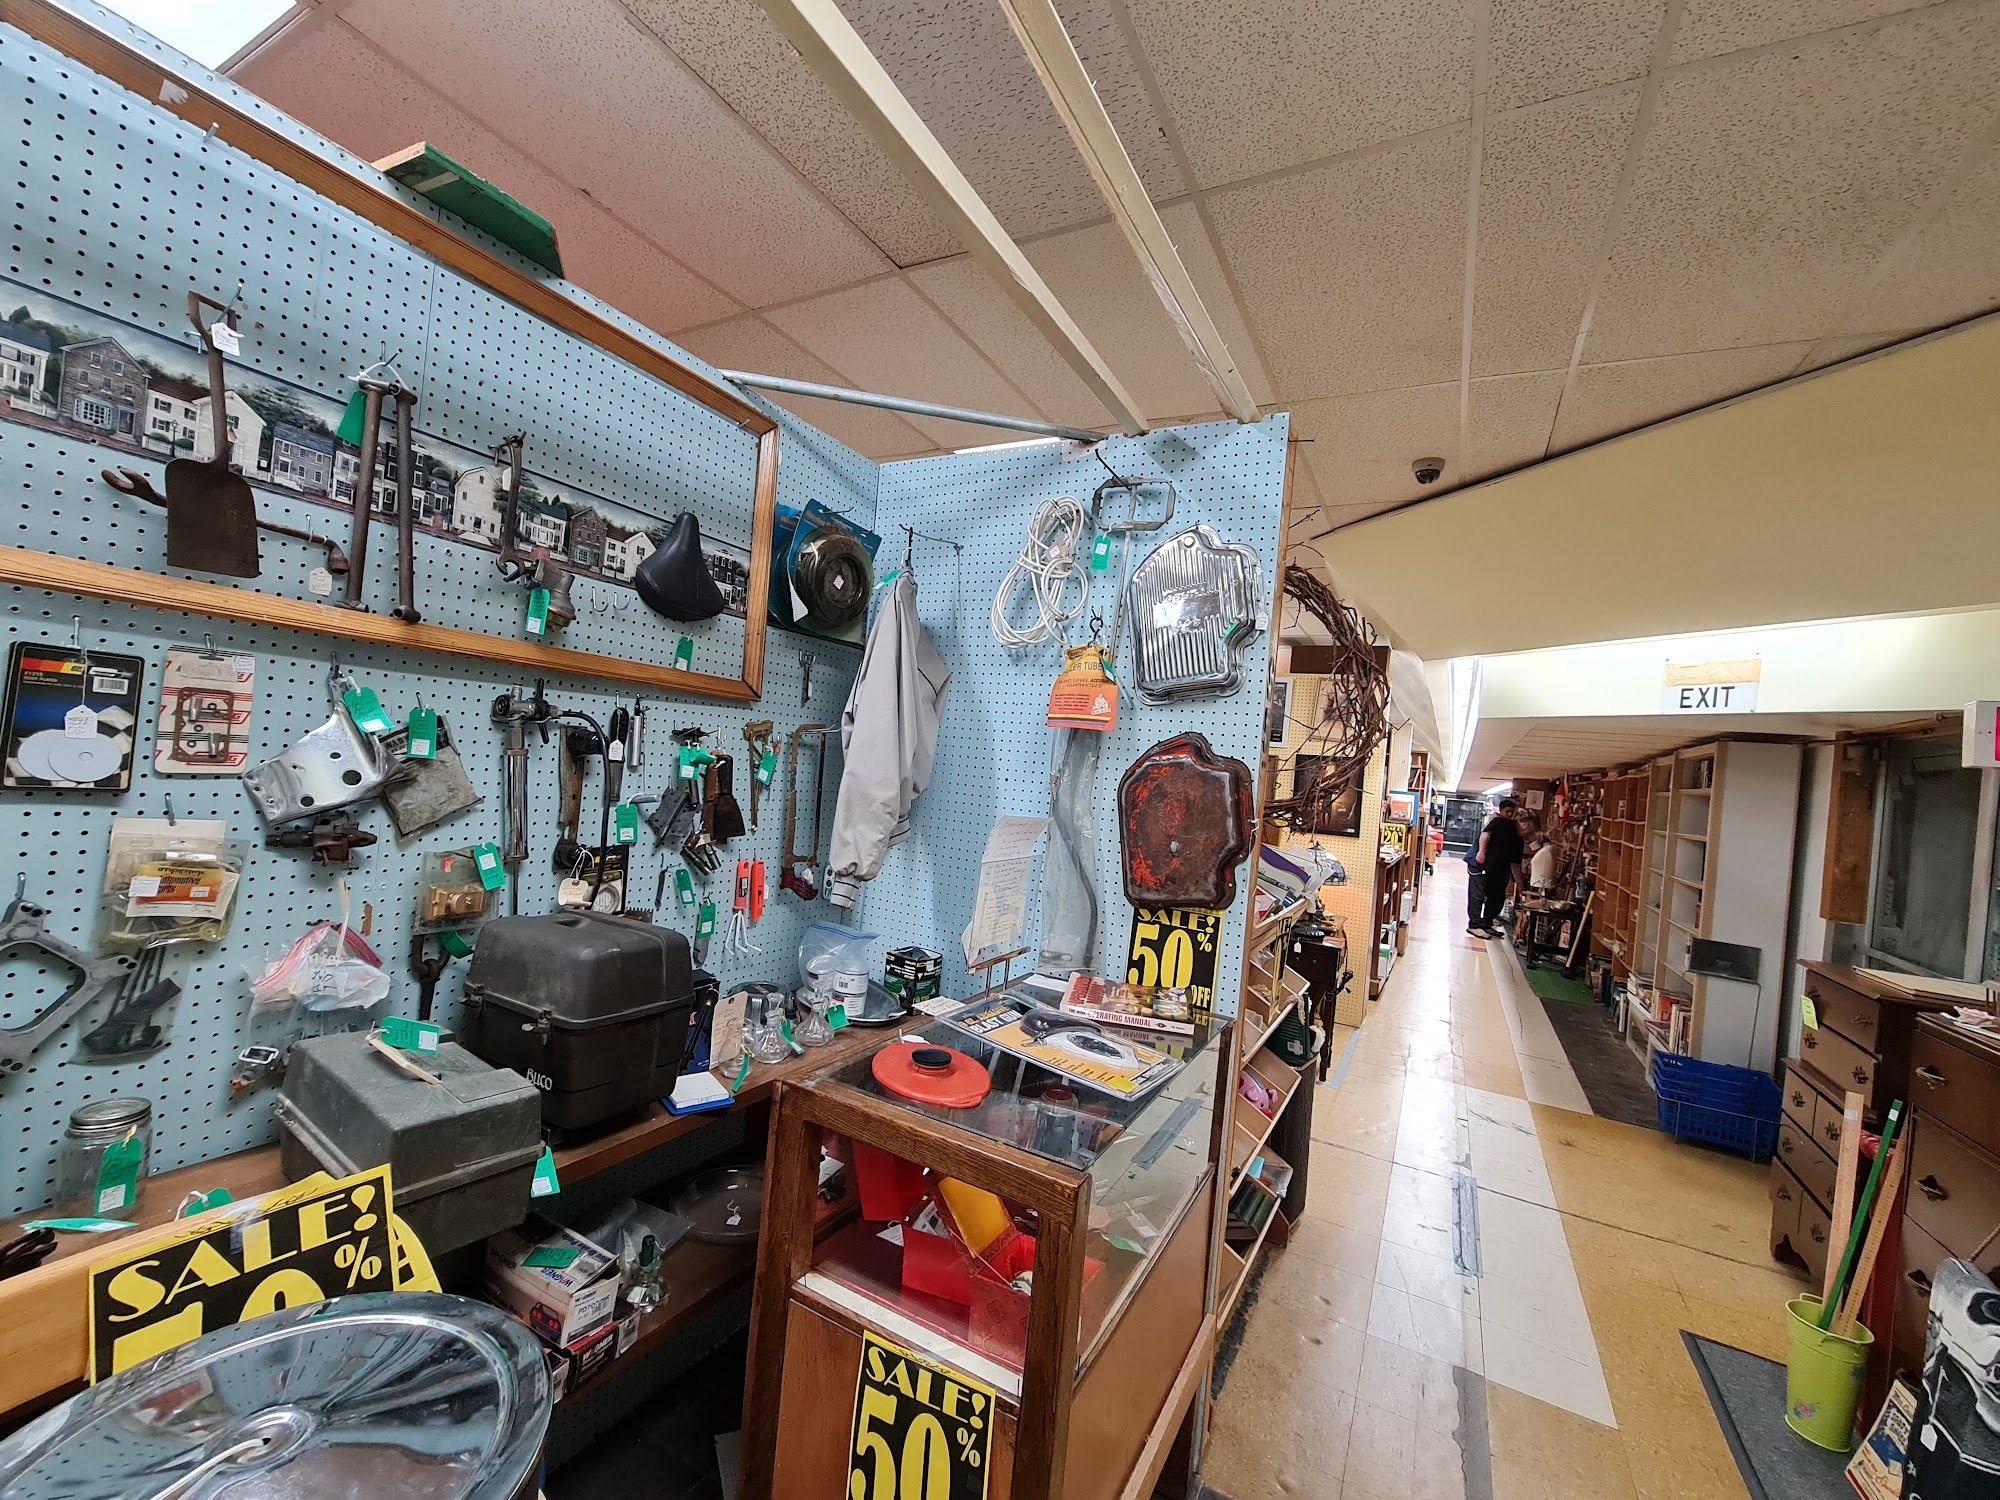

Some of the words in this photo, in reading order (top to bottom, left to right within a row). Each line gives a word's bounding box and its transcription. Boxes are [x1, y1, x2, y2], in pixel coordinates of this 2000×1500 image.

[1679, 686, 1736, 709] EXIT
[157, 884, 177, 894] arts
[1138, 909, 1216, 934] SALE!
[969, 1016, 1005, 1034] BLAST
[999, 1009, 1024, 1022] GUN
[1124, 1014, 1152, 1027] MANUAL
[526, 1067, 553, 1091] BUCO
[107, 1184, 376, 1322] SALE!
[865, 1346, 986, 1430] SALE!
